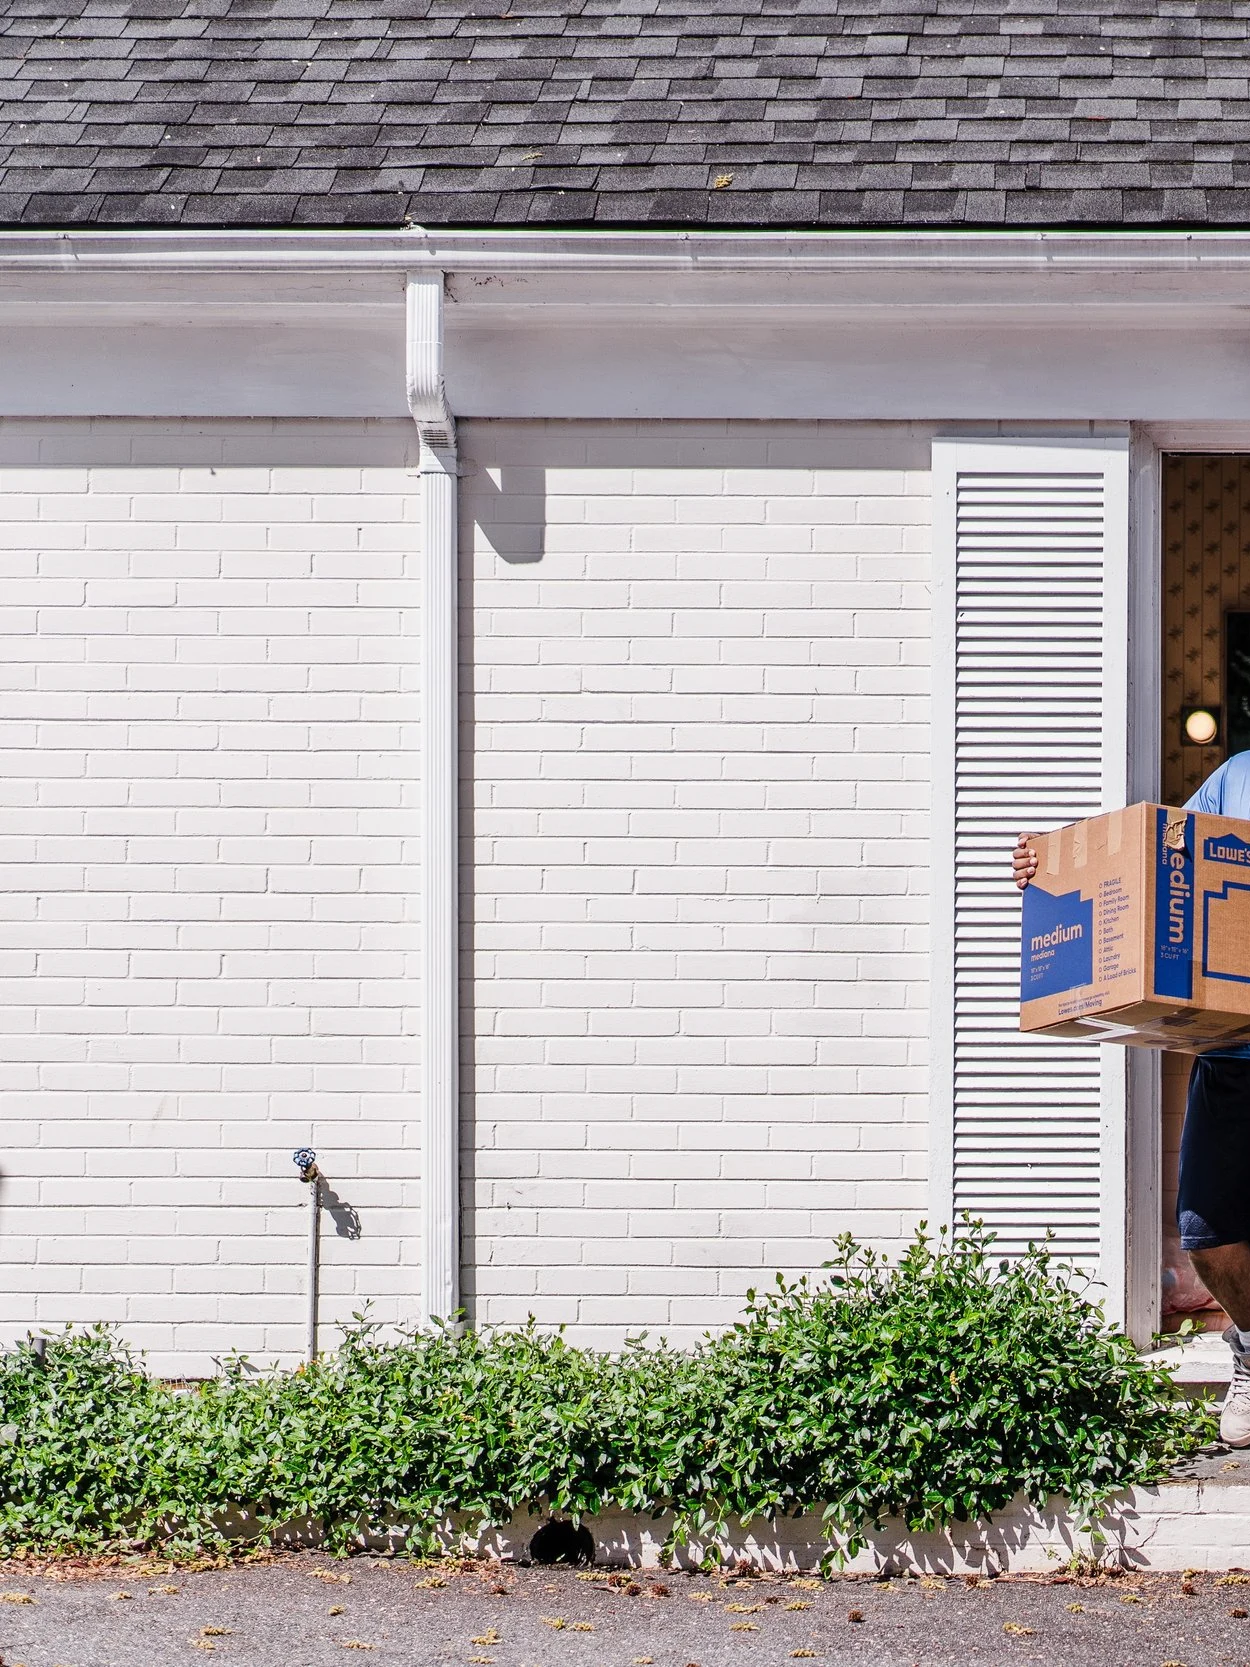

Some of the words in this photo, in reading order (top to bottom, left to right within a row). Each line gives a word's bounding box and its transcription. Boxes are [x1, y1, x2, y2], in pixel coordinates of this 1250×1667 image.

[1103, 877, 1121, 888] FRAGILE
[1103, 888, 1122, 897] Bedroom
[1169, 852, 1191, 943] edium
[1103, 898, 1116, 907] Family
[1103, 907, 1116, 916] Dining
[1103, 916, 1119, 925] Kitchen
[1031, 924, 1083, 951] medium
[1103, 933, 1124, 944] Basement
[1103, 945, 1113, 953] Attic
[1031, 950, 1055, 961] mediana
[1103, 953, 1120, 962] Laundry
[1103, 963, 1119, 972] Garage
[1107, 972, 1118, 980] Load
[1123, 967, 1136, 976] Bricks
